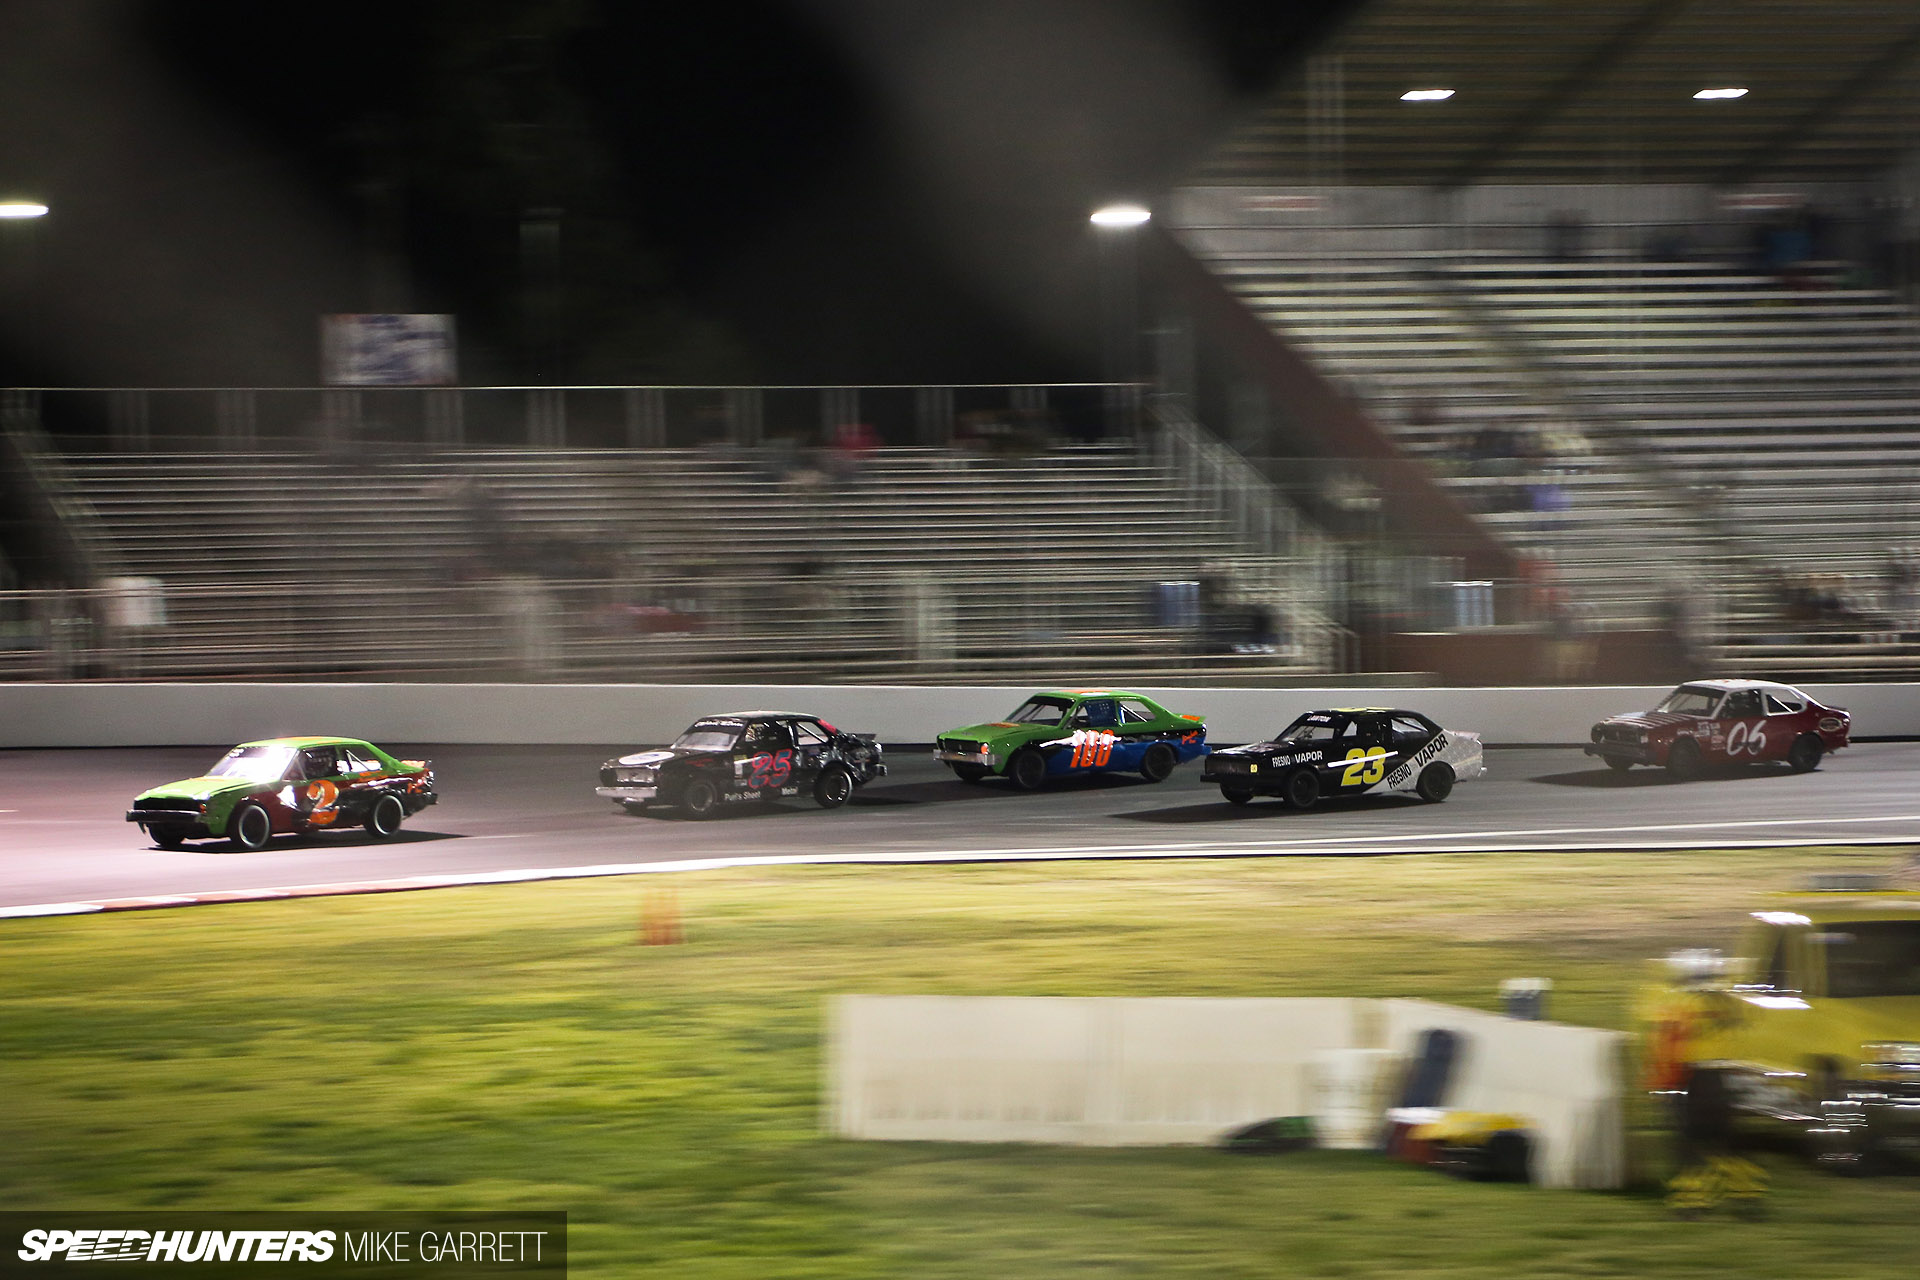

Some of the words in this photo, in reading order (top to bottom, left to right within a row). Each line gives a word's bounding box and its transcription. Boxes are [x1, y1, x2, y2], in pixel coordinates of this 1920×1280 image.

[748, 748, 793, 789] 25
[1271, 754, 1291, 768] FRESNO
[1294, 750, 1323, 764] VAPOR
[1340, 746, 1387, 787] 23
[1386, 763, 1412, 790] FRESNO
[1414, 733, 1449, 768] VAPOR
[306, 779, 340, 825] 2
